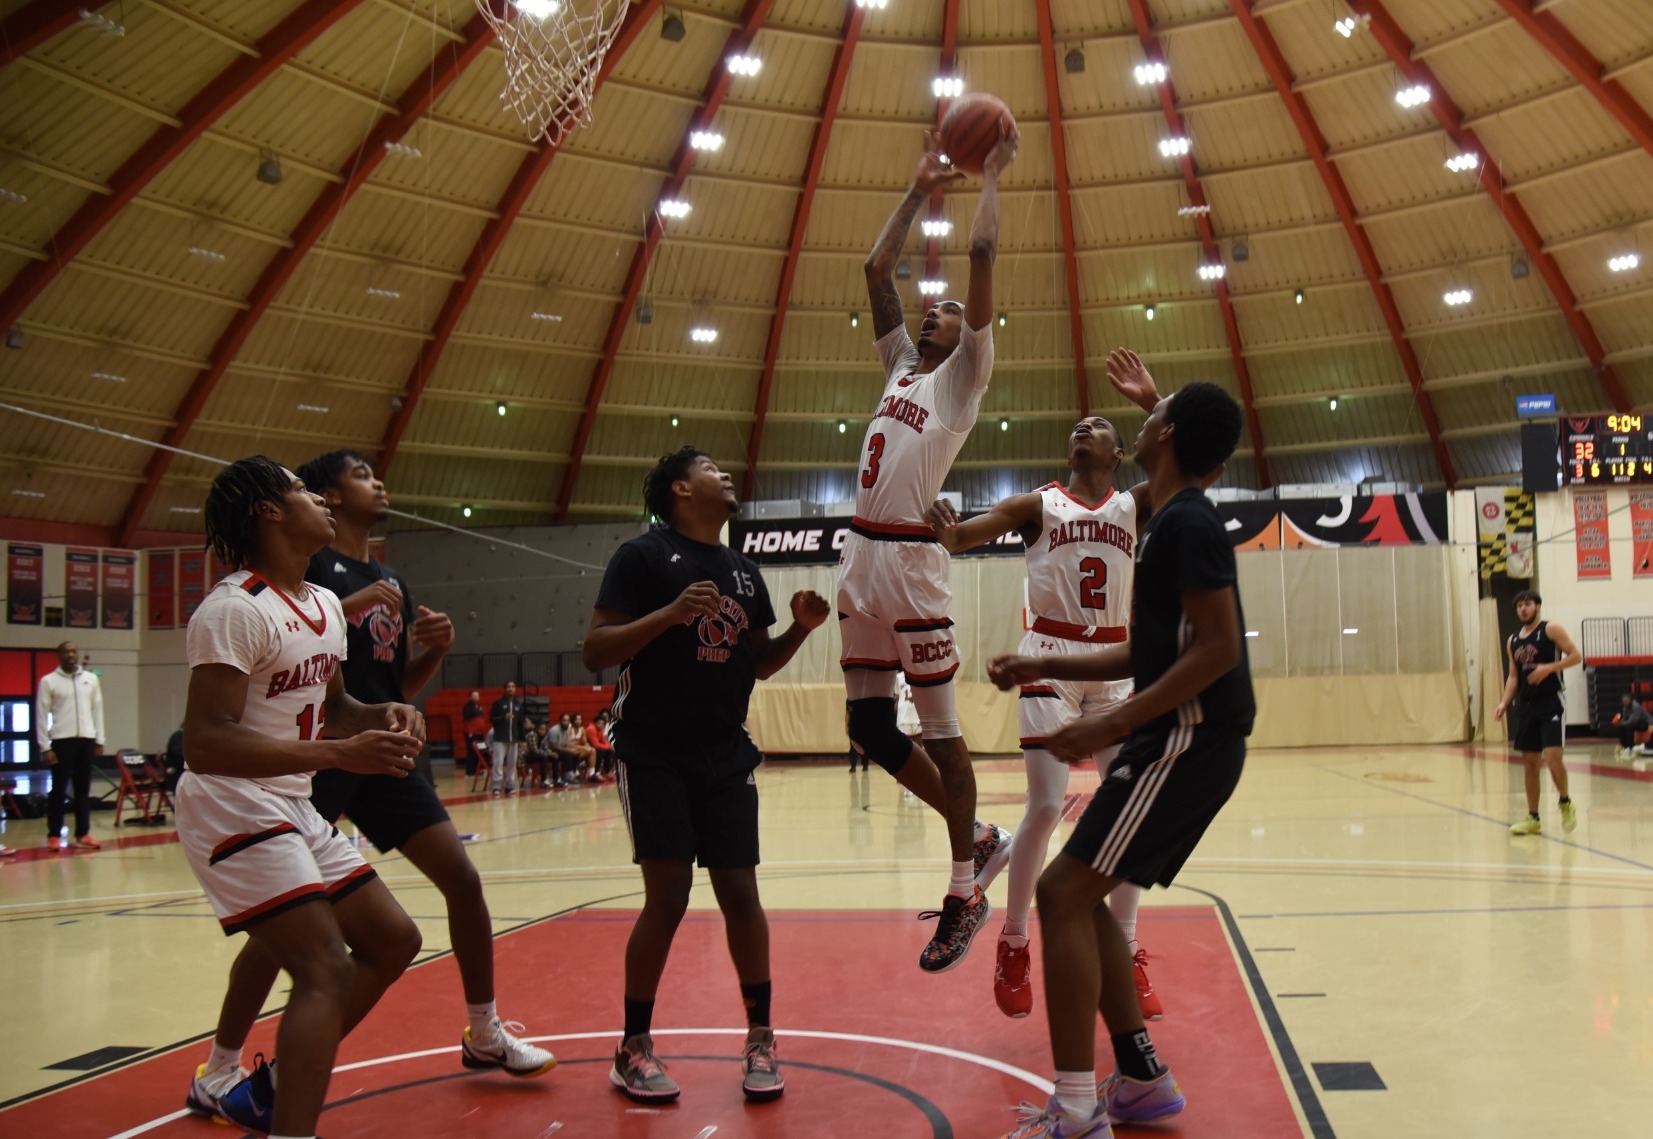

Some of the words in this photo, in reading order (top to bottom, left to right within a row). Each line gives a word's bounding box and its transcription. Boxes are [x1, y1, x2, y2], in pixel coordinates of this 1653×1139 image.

[1529, 400, 1552, 409] PEPSI
[1607, 414, 1641, 433] 9:04
[861, 433, 886, 489] 3
[1575, 442, 1594, 460] 32
[1620, 443, 1625, 456] 1
[1575, 463, 1583, 478] 3
[742, 529, 823, 553] HOME
[1048, 520, 1133, 559] BALTIMORE
[732, 570, 755, 597] 15
[1079, 556, 1107, 610] 2
[910, 640, 952, 663] BCCC
